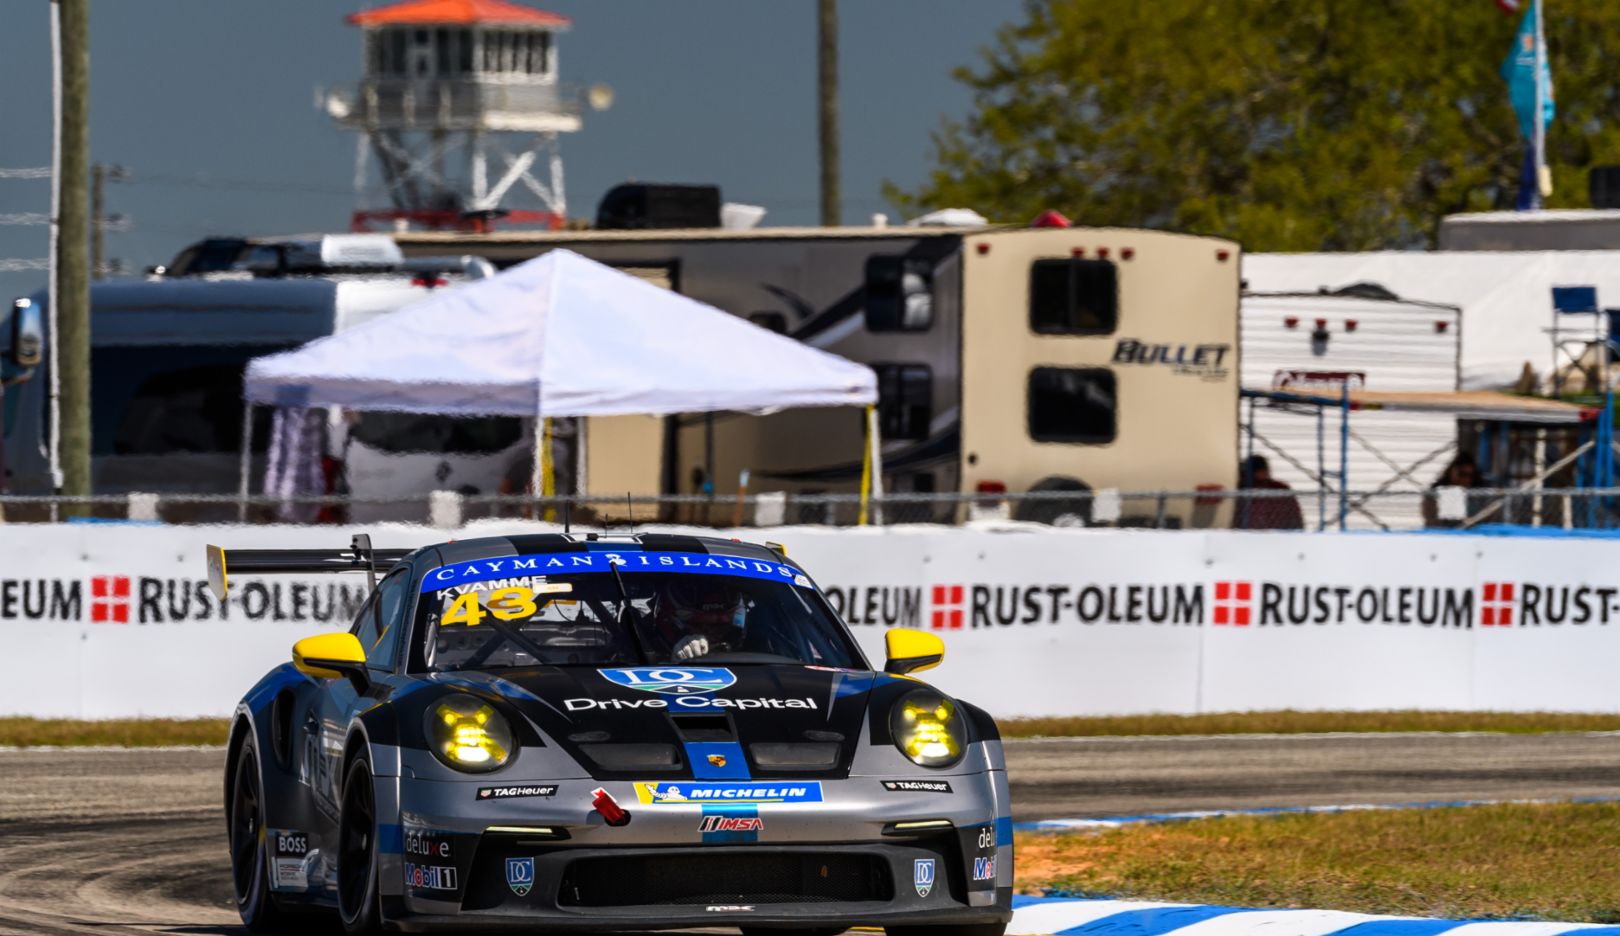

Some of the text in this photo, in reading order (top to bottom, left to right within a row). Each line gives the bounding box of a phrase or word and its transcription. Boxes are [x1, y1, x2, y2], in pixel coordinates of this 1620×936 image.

[1112, 338, 1231, 366] BULLET
[436, 555, 793, 581] CAYMAN ISLANDS
[436, 575, 548, 601] KVAMME
[440, 586, 538, 627] 43
[971, 583, 1204, 629] RUST-OLEUM
[1259, 582, 1474, 628] RUST-OLEUM
[616, 667, 722, 685] DC
[563, 696, 818, 712] Drive Capital
[690, 786, 806, 799] MICHELIN
[717, 816, 763, 832] IMSA
[278, 836, 307, 853] BOSS
[406, 830, 450, 858] deluxe
[405, 862, 440, 889] Mobil
[509, 860, 531, 883] DC
[917, 861, 932, 884] DC
